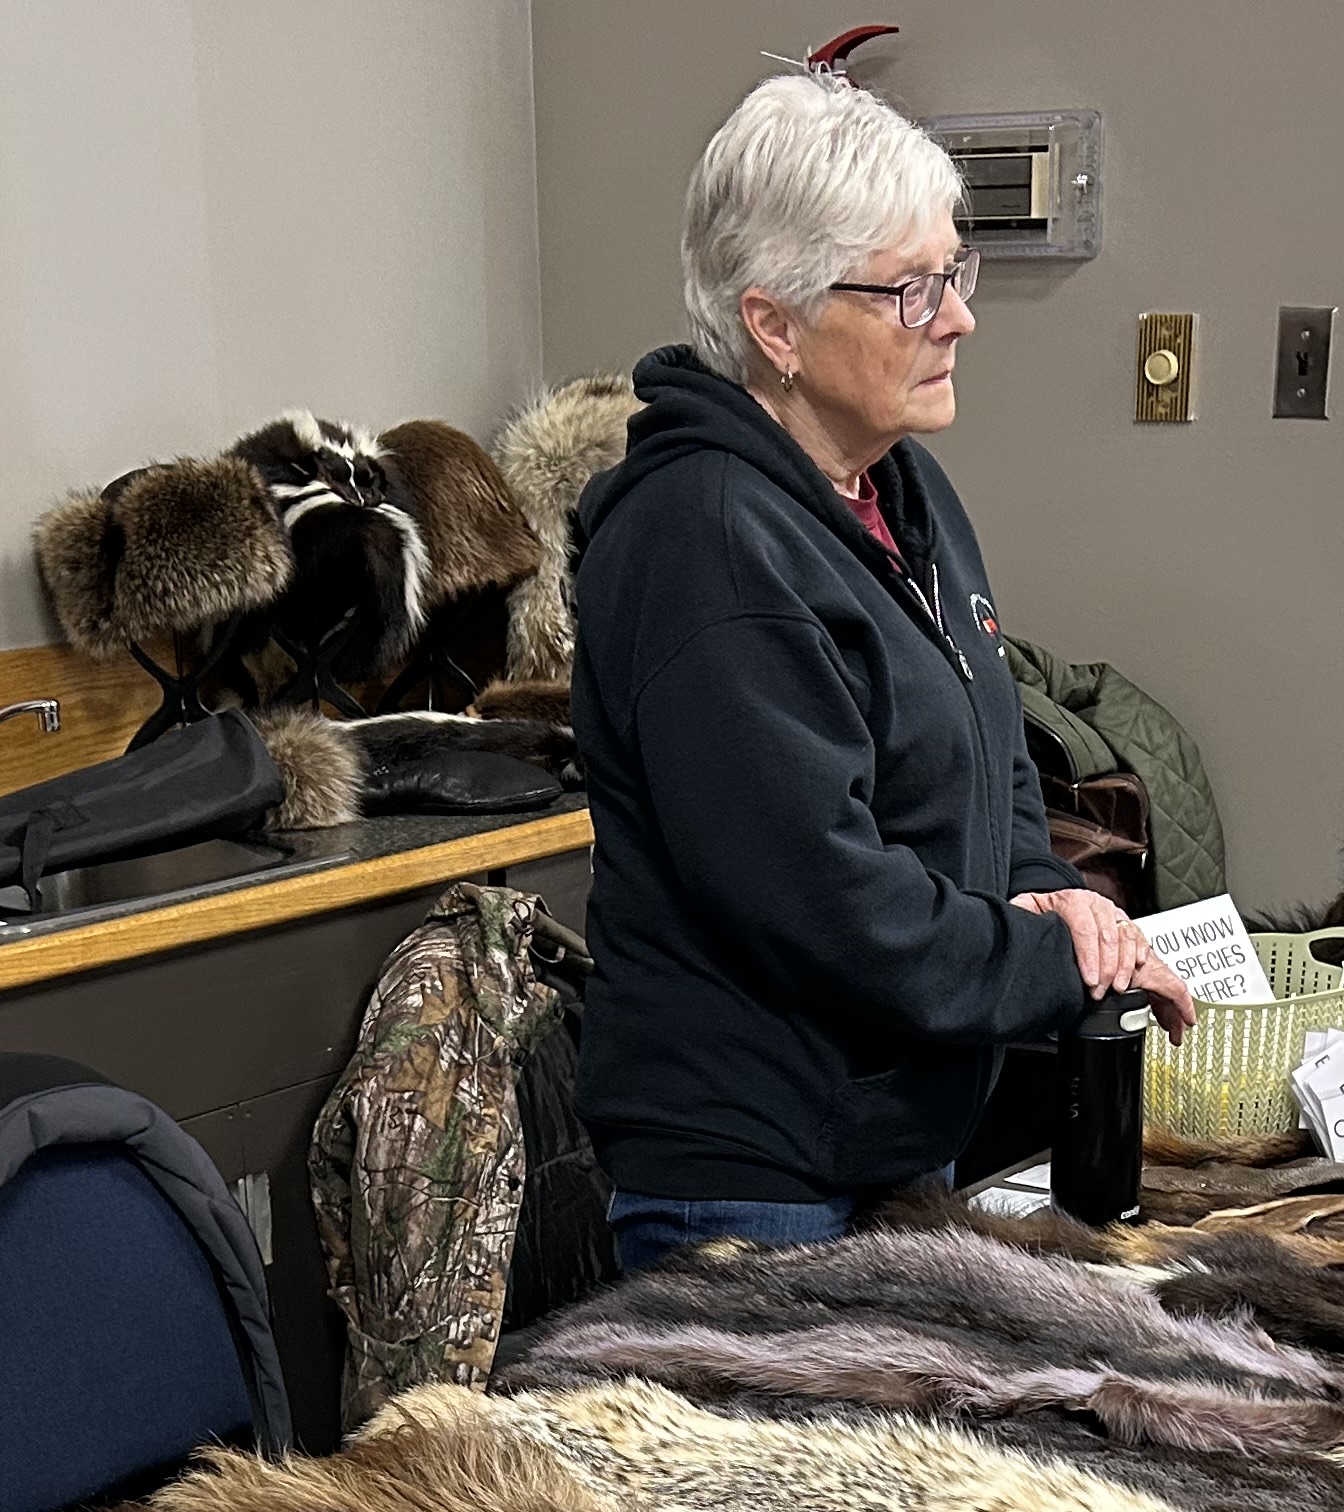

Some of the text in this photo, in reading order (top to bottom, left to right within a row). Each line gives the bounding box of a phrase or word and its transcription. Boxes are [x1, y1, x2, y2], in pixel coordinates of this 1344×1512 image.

[1180, 915, 1234, 949] KNOW
[1176, 944, 1246, 980] SPECIES
[1194, 974, 1247, 1003] HERE?
